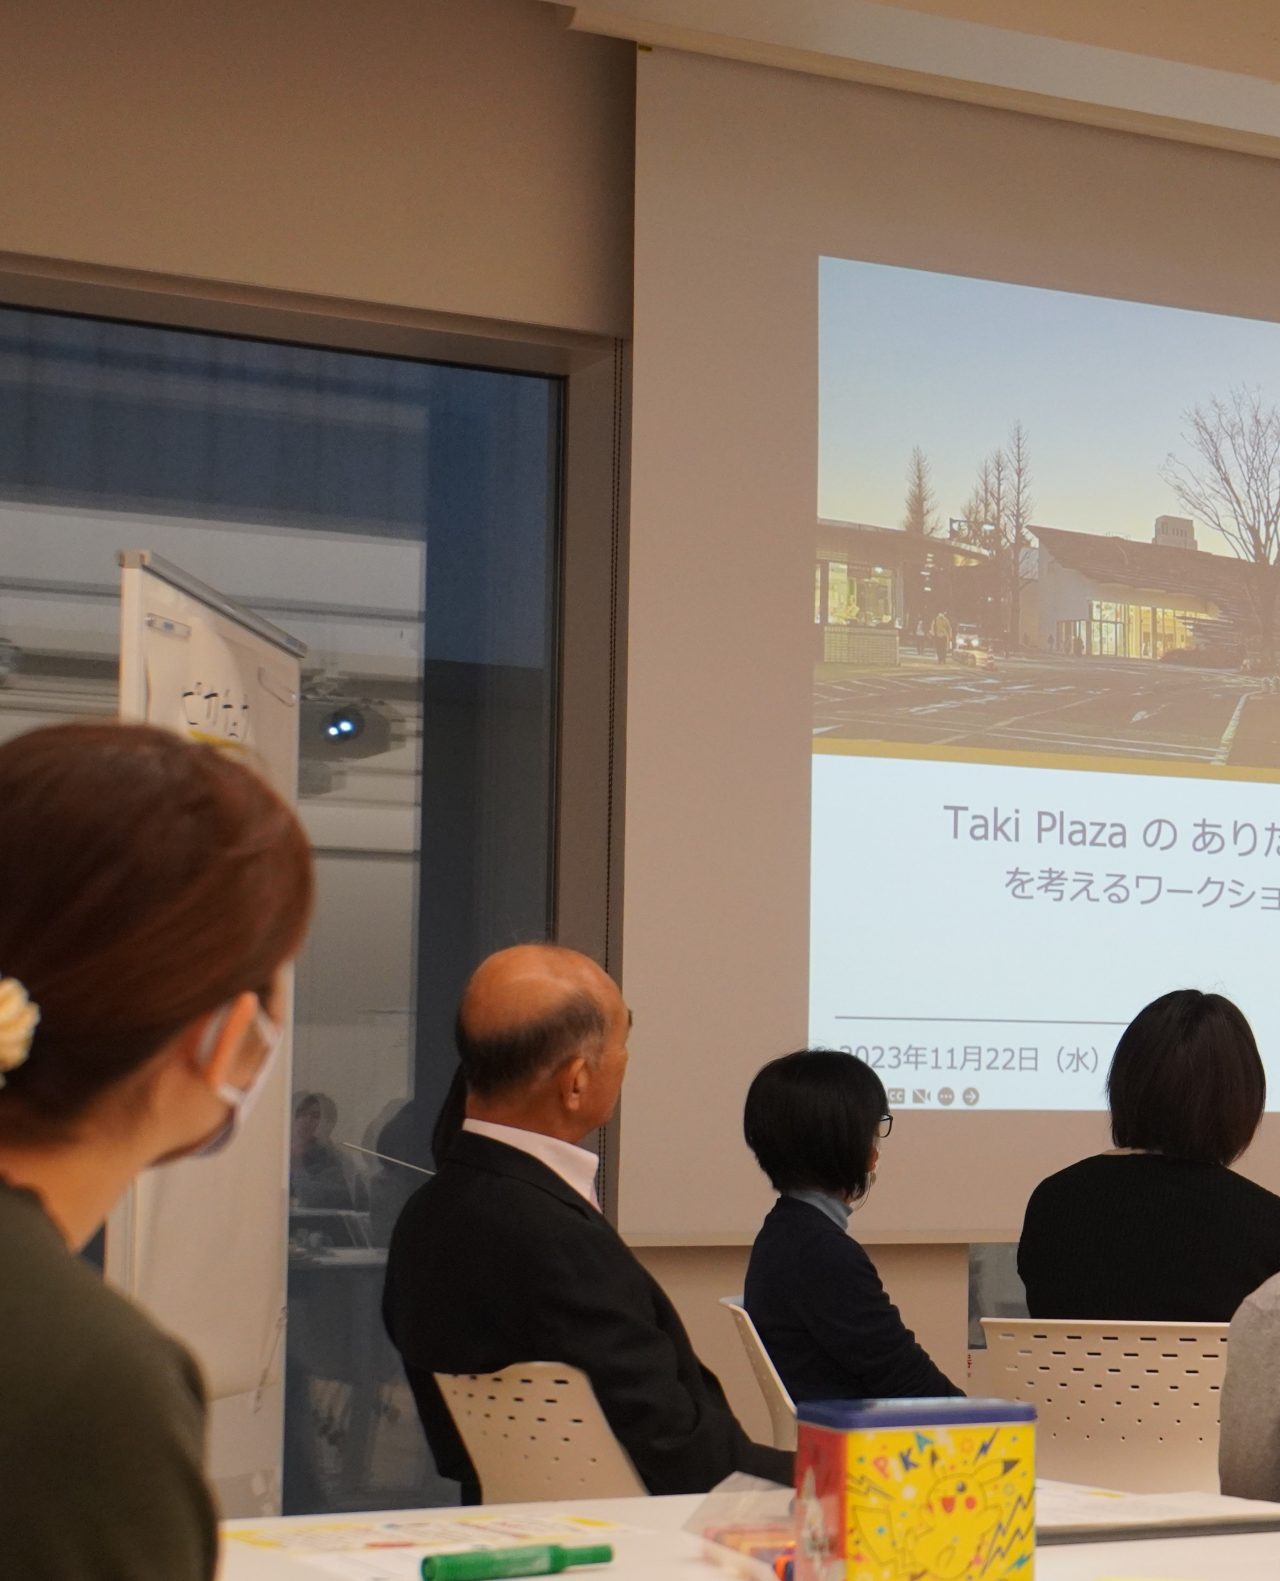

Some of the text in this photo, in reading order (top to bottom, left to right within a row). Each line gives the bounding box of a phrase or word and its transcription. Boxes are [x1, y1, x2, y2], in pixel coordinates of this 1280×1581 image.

[943, 804, 1021, 843] Taki
[1036, 809, 1128, 850] Plaza
[1142, 818, 1178, 851] の
